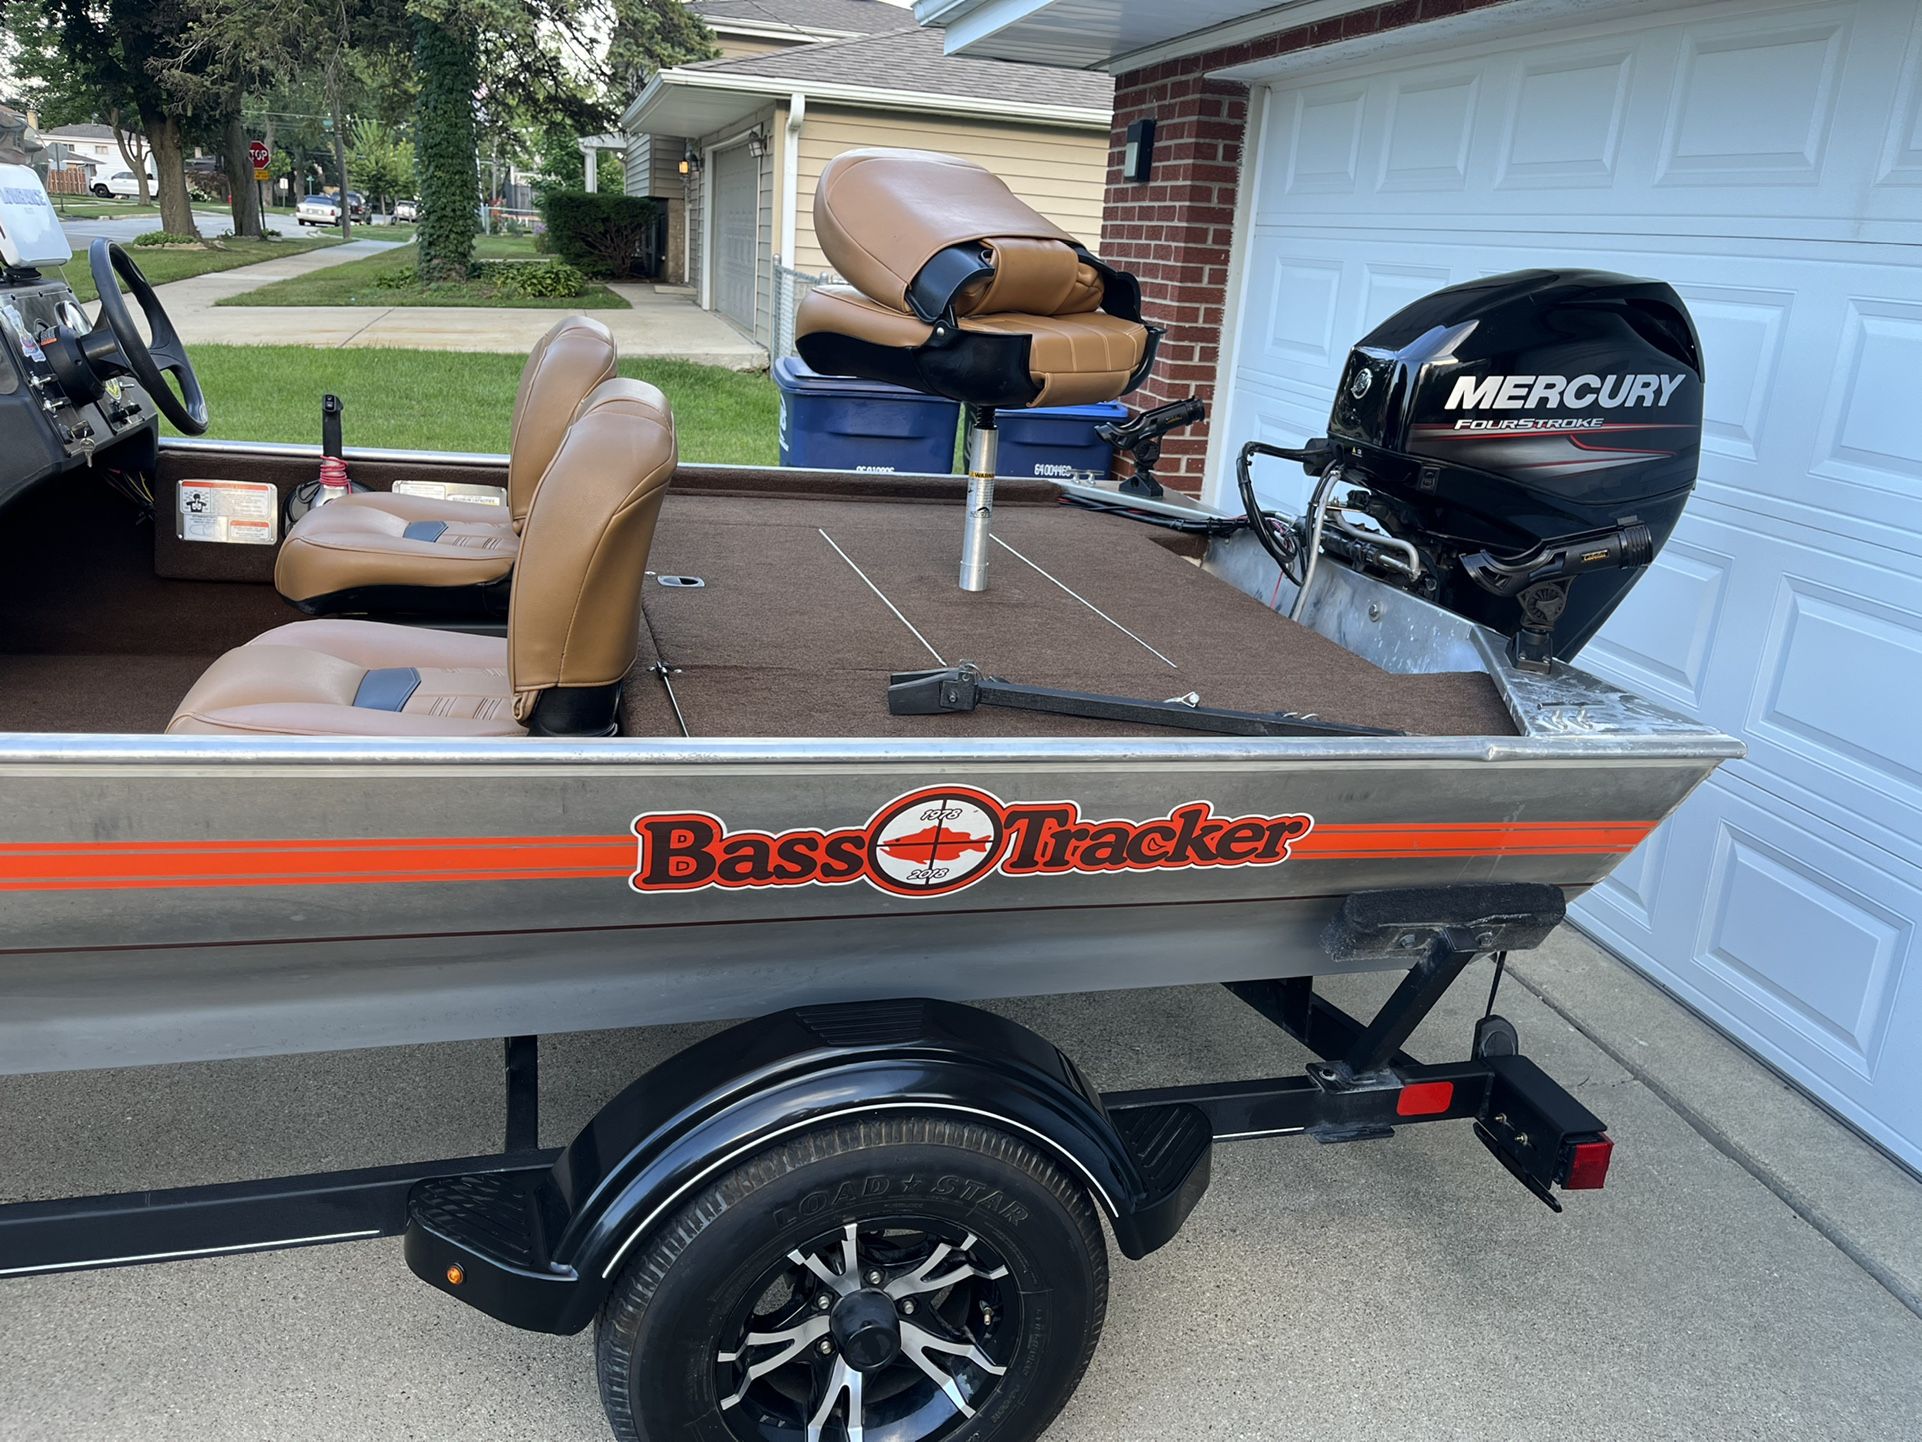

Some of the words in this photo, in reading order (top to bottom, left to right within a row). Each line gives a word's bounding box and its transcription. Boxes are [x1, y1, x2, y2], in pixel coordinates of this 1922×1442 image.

[249, 149, 268, 161] TOP
[1444, 373, 1687, 410] MERCURY
[974, 471, 995, 479] WARN
[920, 808, 963, 821] 1978
[640, 818, 868, 886] Bass
[1002, 805, 1307, 871] Tracker
[906, 868, 950, 880] 2018
[773, 1174, 891, 1230] LOAD
[929, 1174, 1030, 1227] STAR
